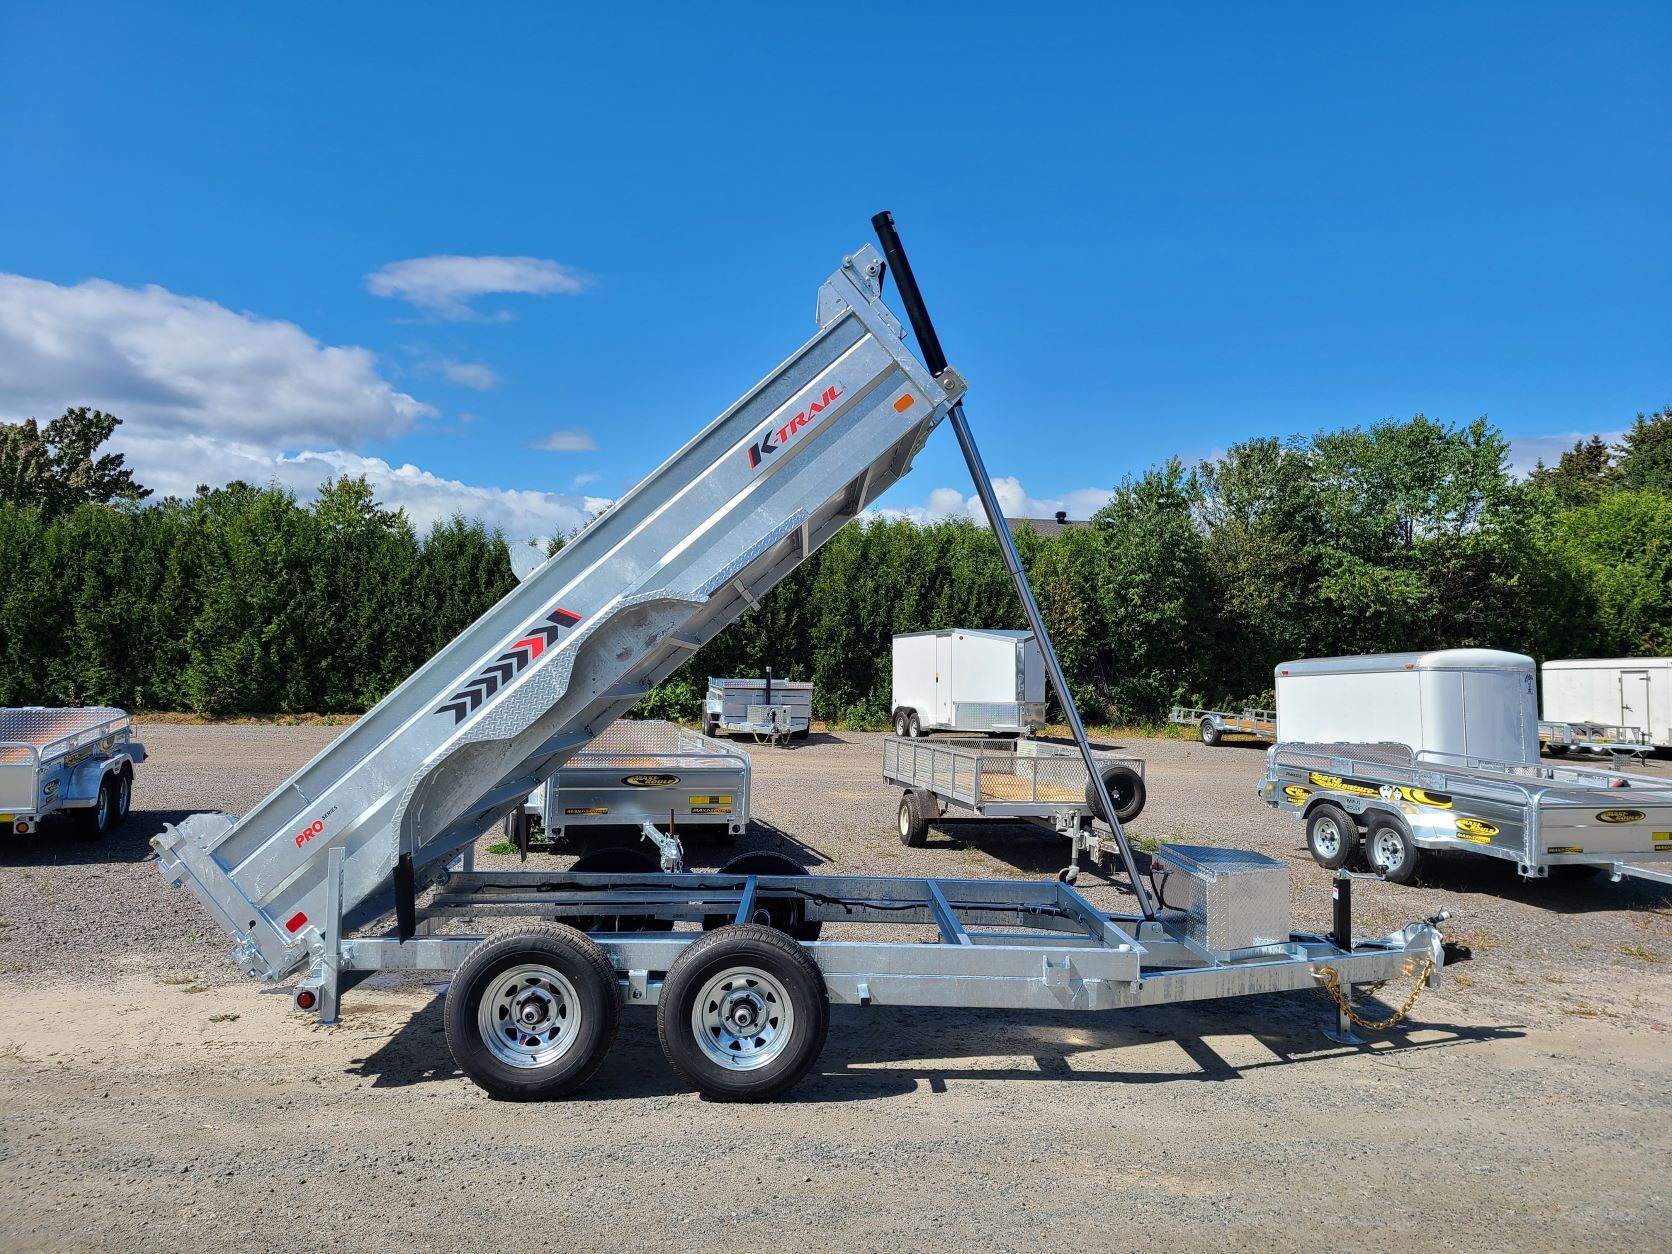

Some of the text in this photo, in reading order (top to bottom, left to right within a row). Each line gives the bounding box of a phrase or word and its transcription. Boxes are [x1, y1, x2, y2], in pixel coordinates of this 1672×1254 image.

[748, 386, 844, 469] K-TRAIL
[295, 805, 338, 848] PRO SERIES
